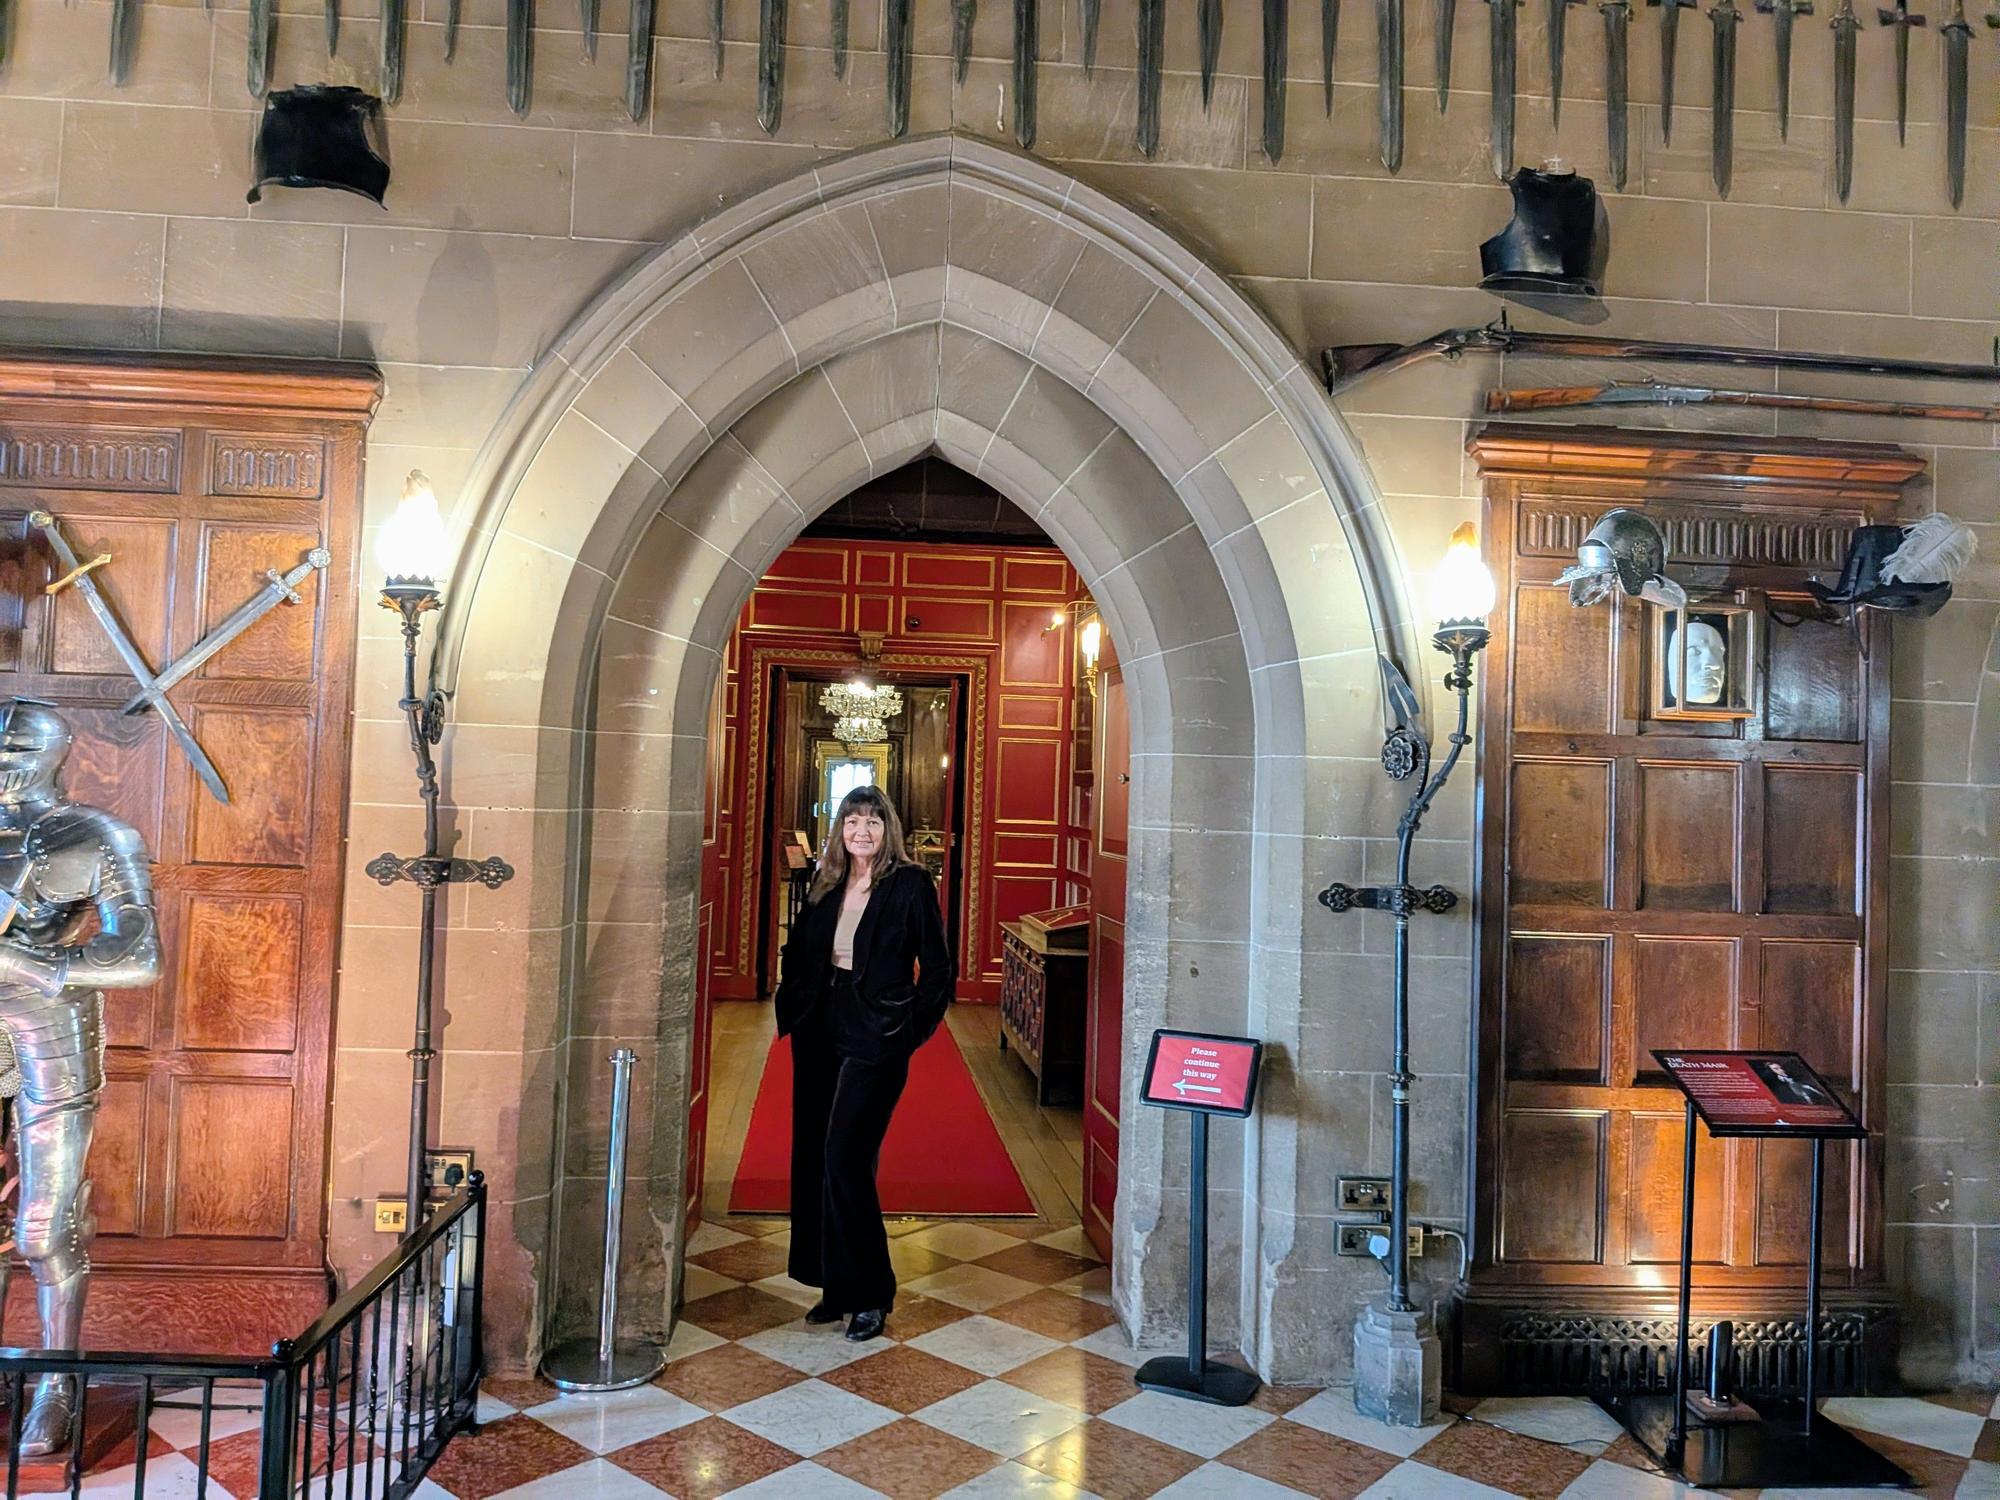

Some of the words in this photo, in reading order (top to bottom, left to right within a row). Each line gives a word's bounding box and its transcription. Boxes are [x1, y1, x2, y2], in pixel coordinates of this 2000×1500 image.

[1191, 1047, 1218, 1057] Please
[1184, 1058, 1221, 1069] continue
[1183, 1069, 1199, 1078] this
[1200, 1072, 1217, 1081] way
